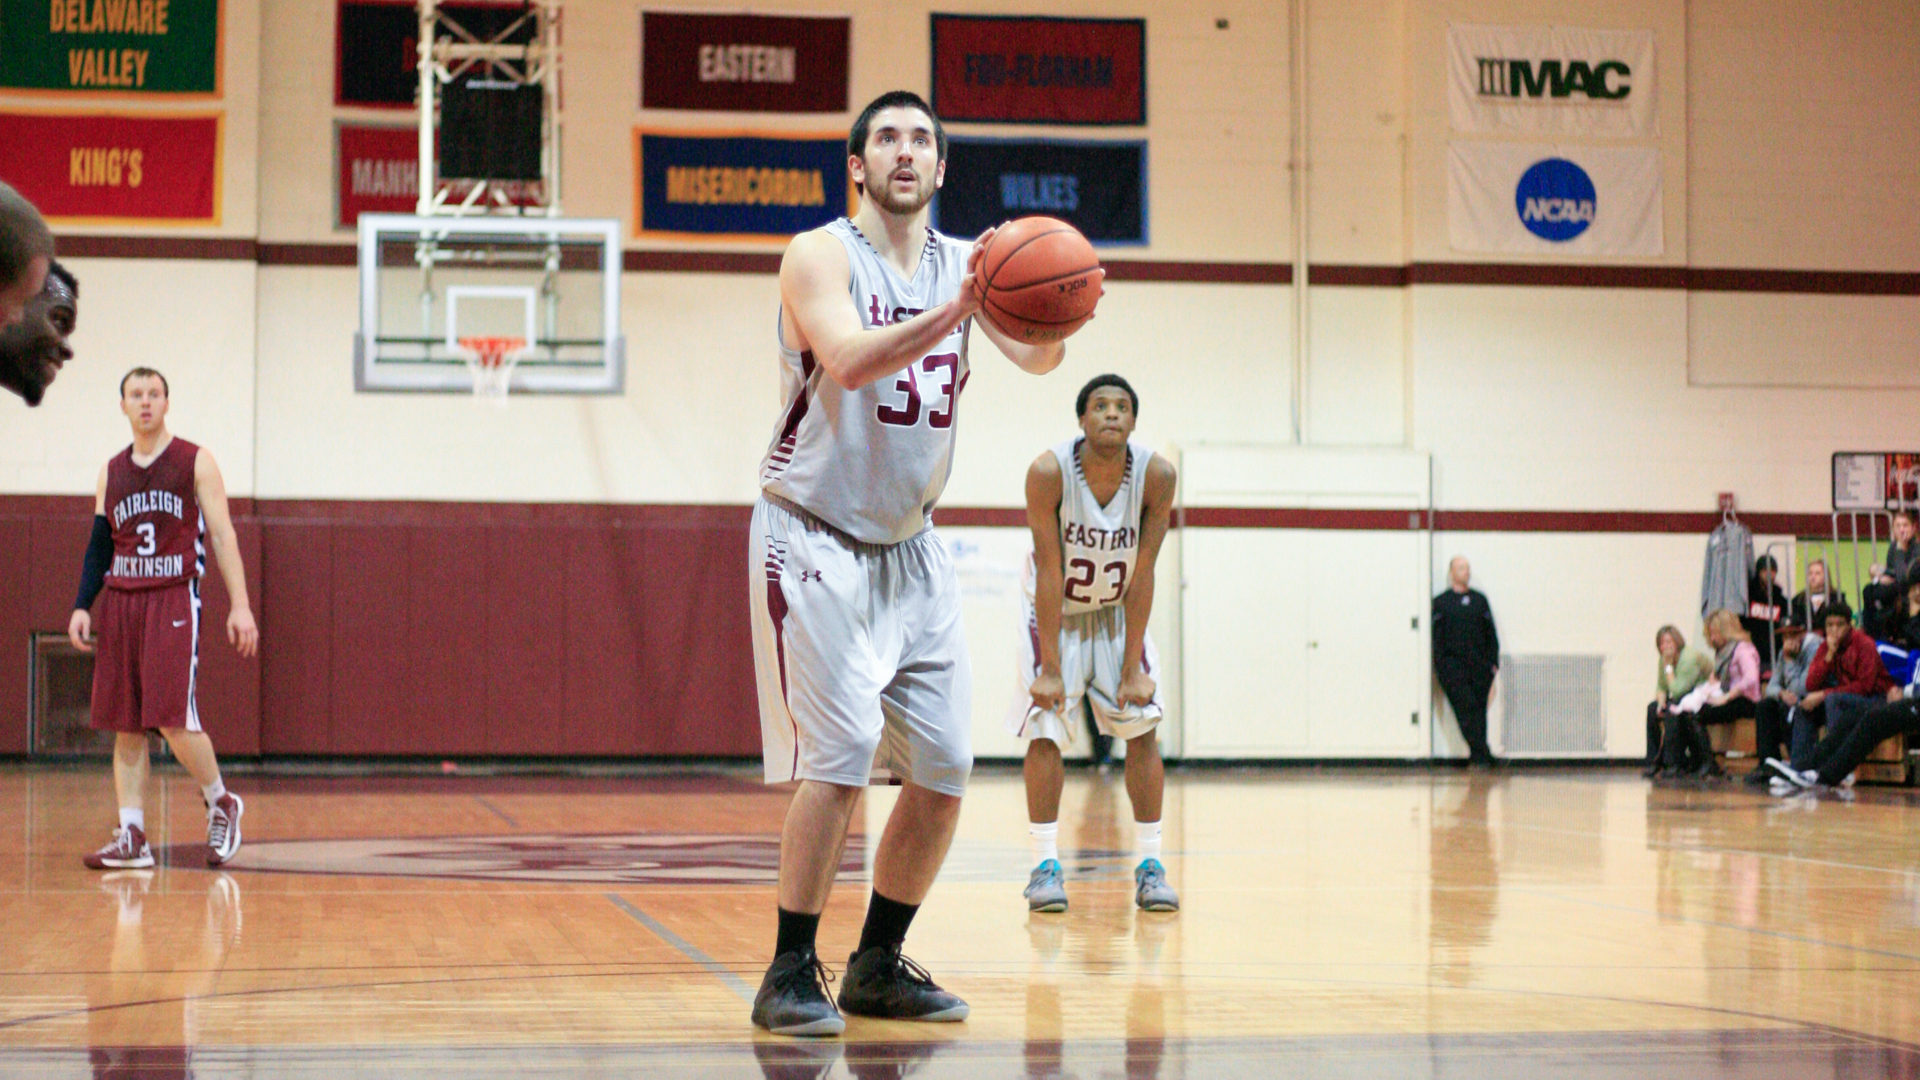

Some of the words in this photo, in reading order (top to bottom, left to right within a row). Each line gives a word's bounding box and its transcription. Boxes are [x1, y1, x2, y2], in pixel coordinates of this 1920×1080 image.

[51, 0, 169, 34] DELAWARE
[68, 49, 149, 87] VALLEY
[699, 45, 797, 83] EASTERN
[69, 147, 143, 188] KING'S
[666, 166, 825, 206] MISERICORDIA
[1001, 173, 1080, 211] WILKES
[1521, 196, 1595, 223] NCAA
[877, 352, 959, 428] 33
[113, 489, 183, 530] FAIRLEIGH
[136, 522, 156, 556] 3
[1065, 521, 1137, 551] EASTERN
[112, 553, 183, 578] DICKINSON
[1065, 557, 1127, 605] 23
